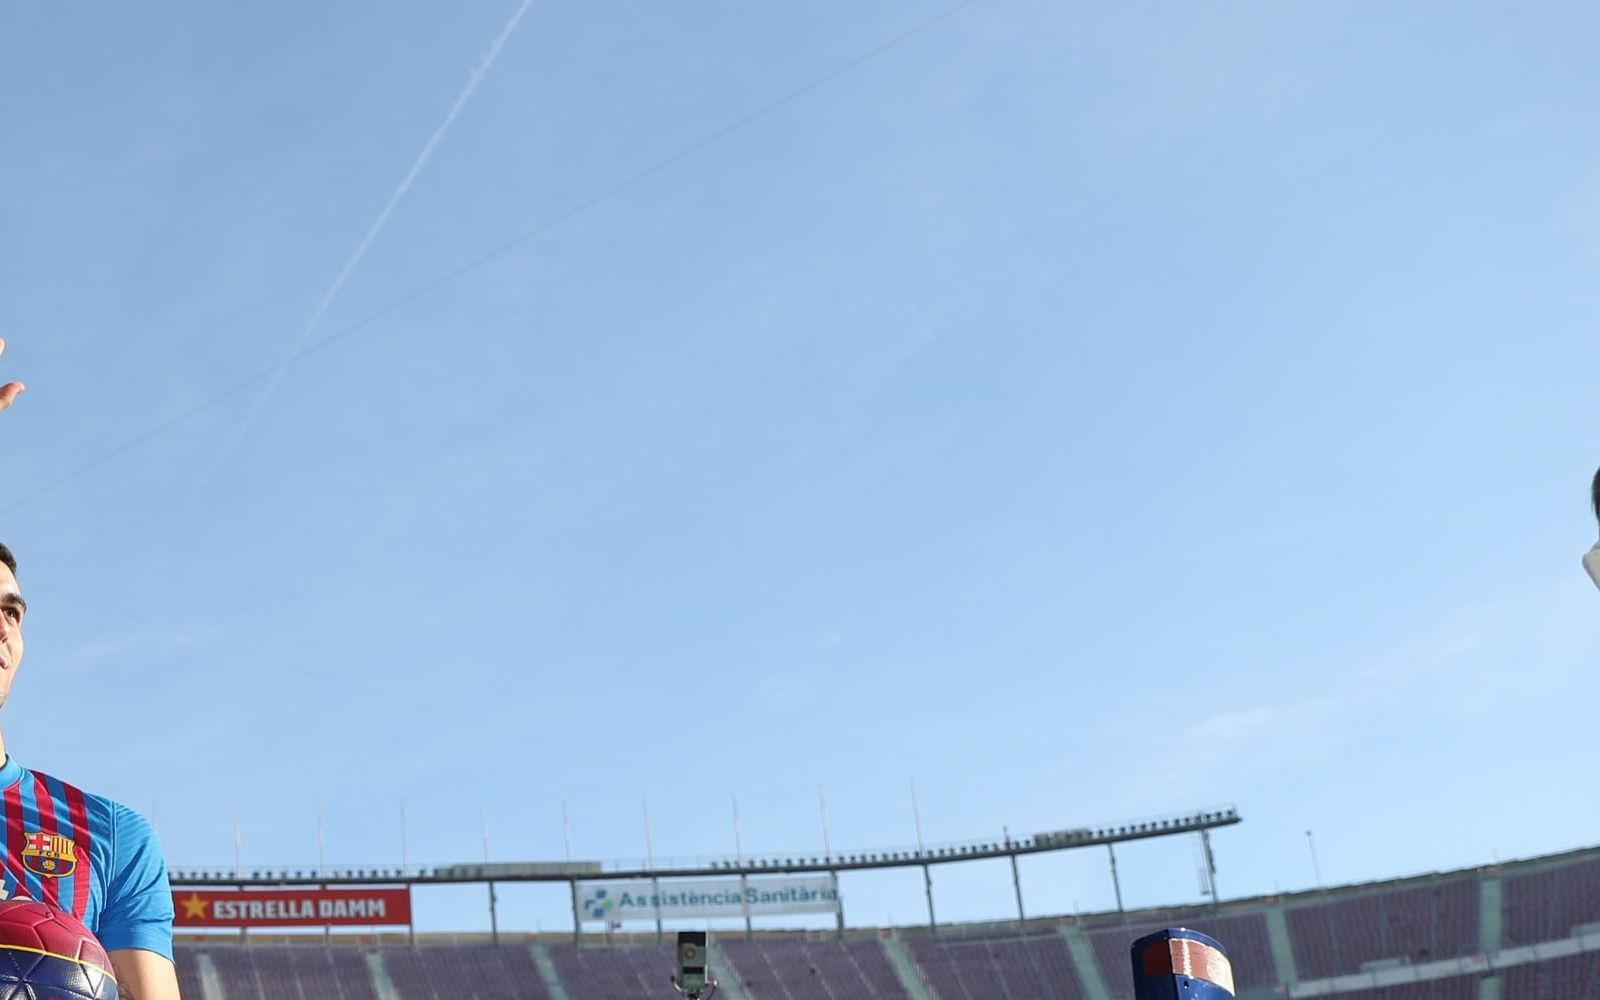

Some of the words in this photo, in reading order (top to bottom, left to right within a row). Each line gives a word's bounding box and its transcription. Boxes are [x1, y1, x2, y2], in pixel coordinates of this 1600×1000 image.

[618, 888, 742, 909] Assistència
[746, 884, 838, 906] Sanitària
[213, 900, 314, 919] ESTRELLA
[319, 899, 386, 918] DAMM
